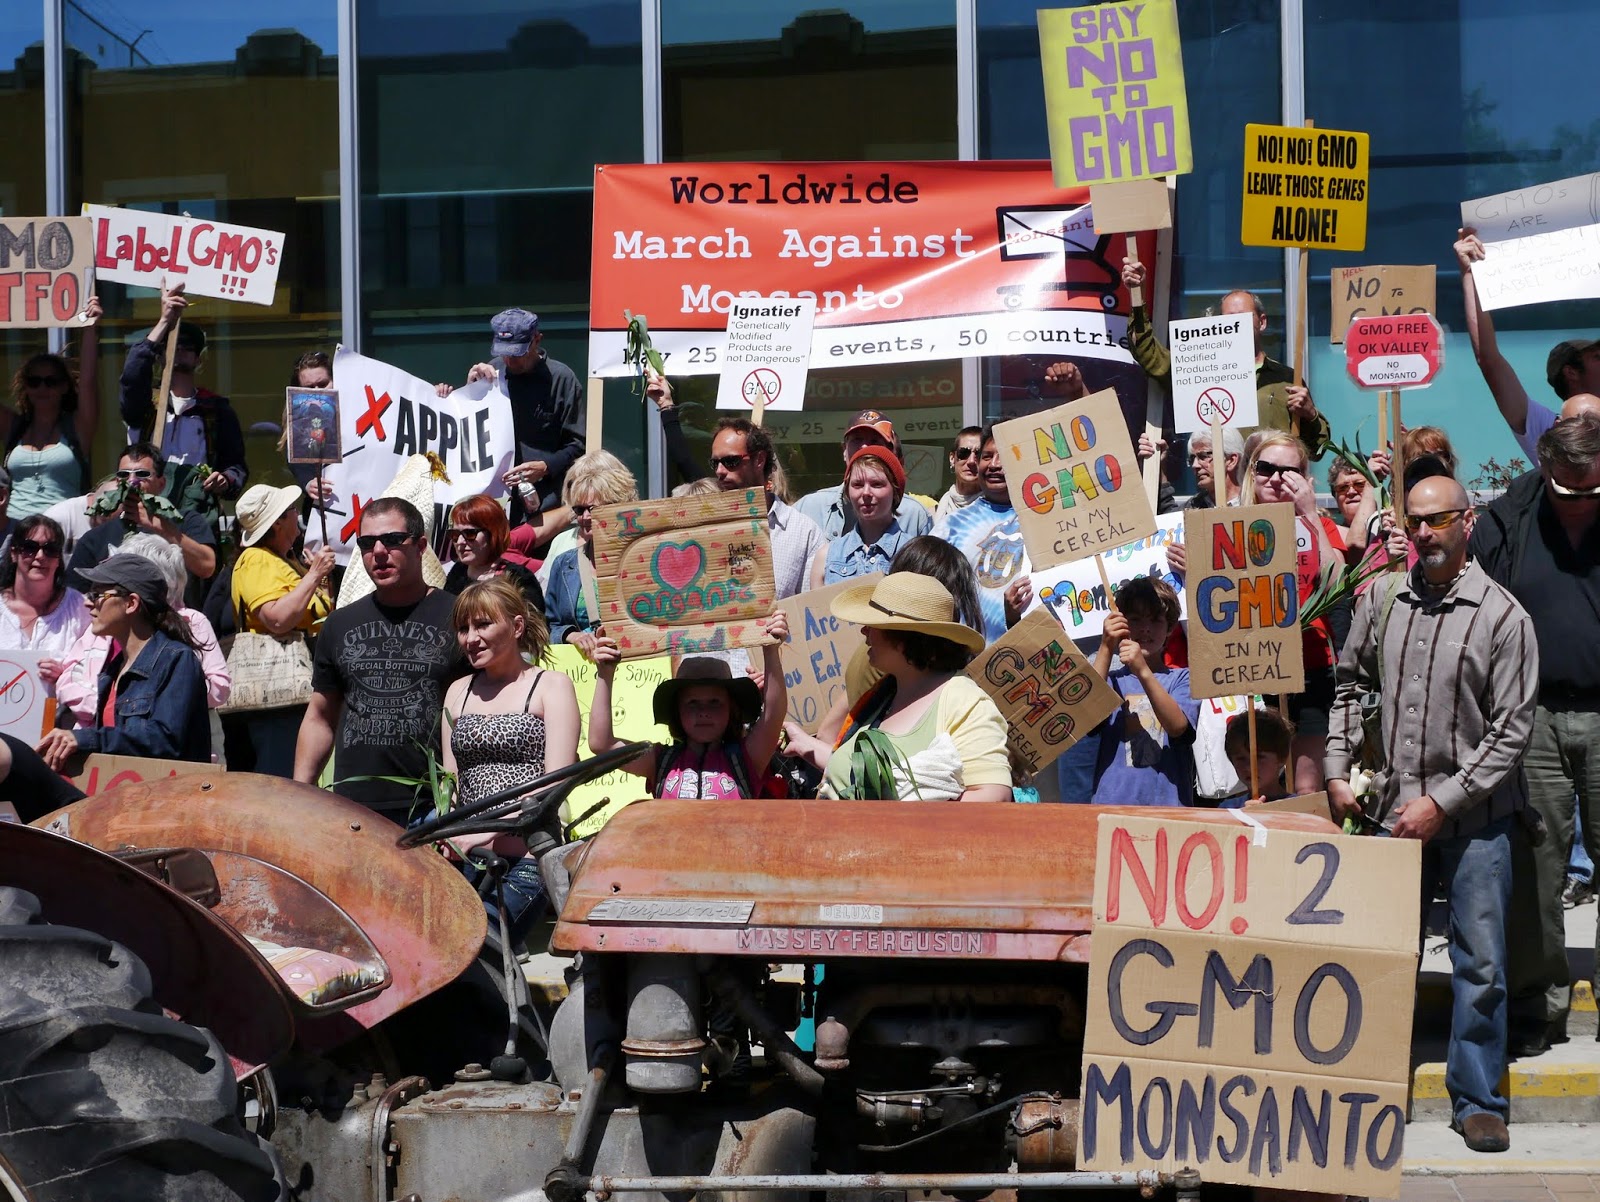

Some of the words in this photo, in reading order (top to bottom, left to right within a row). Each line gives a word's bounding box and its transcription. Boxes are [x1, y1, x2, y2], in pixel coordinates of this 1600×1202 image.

[1071, 3, 1146, 44] SAY
[1066, 37, 1158, 89] NO
[1092, 83, 1149, 112] TO
[1068, 105, 1177, 182] GMO
[1257, 134, 1283, 164] NO!
[1286, 137, 1313, 166] NO!
[1316, 133, 1358, 170] GMO
[669, 173, 919, 205] Worldwide
[1247, 171, 1282, 197] LEAVE
[1284, 173, 1325, 199] THOSE
[1326, 177, 1366, 202] GENES
[1006, 217, 1094, 245] Monsant
[1271, 205, 1339, 243] ALONE!
[1506, 214, 1549, 232] ARE
[0, 220, 74, 271] MO
[186, 223, 279, 274] GMO's
[612, 227, 753, 260] March
[778, 226, 978, 267] Against
[219, 273, 249, 297] !!!
[1346, 277, 1381, 302] NO
[733, 304, 802, 320] Ignatief
[729, 332, 772, 341] Modified
[1174, 321, 1241, 342] Ignatief
[1358, 323, 1393, 336] GMO
[1397, 322, 1429, 335] FREE
[687, 346, 718, 364] 25
[829, 335, 937, 356] events,
[958, 328, 989, 347] 50
[1007, 326, 1130, 350] countrie
[726, 354, 743, 362] not
[727, 342, 773, 352] Products
[775, 344, 793, 352] are
[1175, 352, 1217, 364] Modified
[1358, 343, 1377, 355] OK
[1381, 341, 1430, 354] VALLEY
[1175, 363, 1219, 375] Products
[1221, 362, 1238, 370] are
[1369, 371, 1418, 381] MONSANTO
[1386, 361, 1400, 369] NO
[1176, 376, 1192, 386] not
[393, 395, 495, 474] APPLE
[1033, 414, 1097, 466] NO
[1022, 453, 1123, 515] GMO
[616, 508, 645, 539] I
[1055, 516, 1078, 534] IN
[1089, 507, 1112, 527] MY
[1053, 522, 1136, 555] CEREAL
[1212, 518, 1276, 571] NO
[1196, 572, 1298, 634] GMO
[343, 619, 451, 648] GUINNESS
[804, 606, 840, 642] Are
[350, 661, 384, 673] SPECIAL
[784, 667, 803, 689] ou
[810, 640, 842, 685] Eat
[1224, 641, 1249, 659] IN
[1258, 640, 1283, 666] MY
[384, 675, 412, 690] STATES
[1027, 639, 1093, 706] NO
[1211, 663, 1292, 685] CEREAL
[366, 706, 403, 715] LONDON
[984, 646, 1076, 746] GMO
[363, 733, 405, 747] Ireland
[1105, 826, 1250, 936] NO!
[1285, 841, 1345, 925] 2
[822, 905, 882, 920] DELUXE
[1107, 938, 1363, 1066] GMO
[1082, 1060, 1406, 1178] MONSANTO
